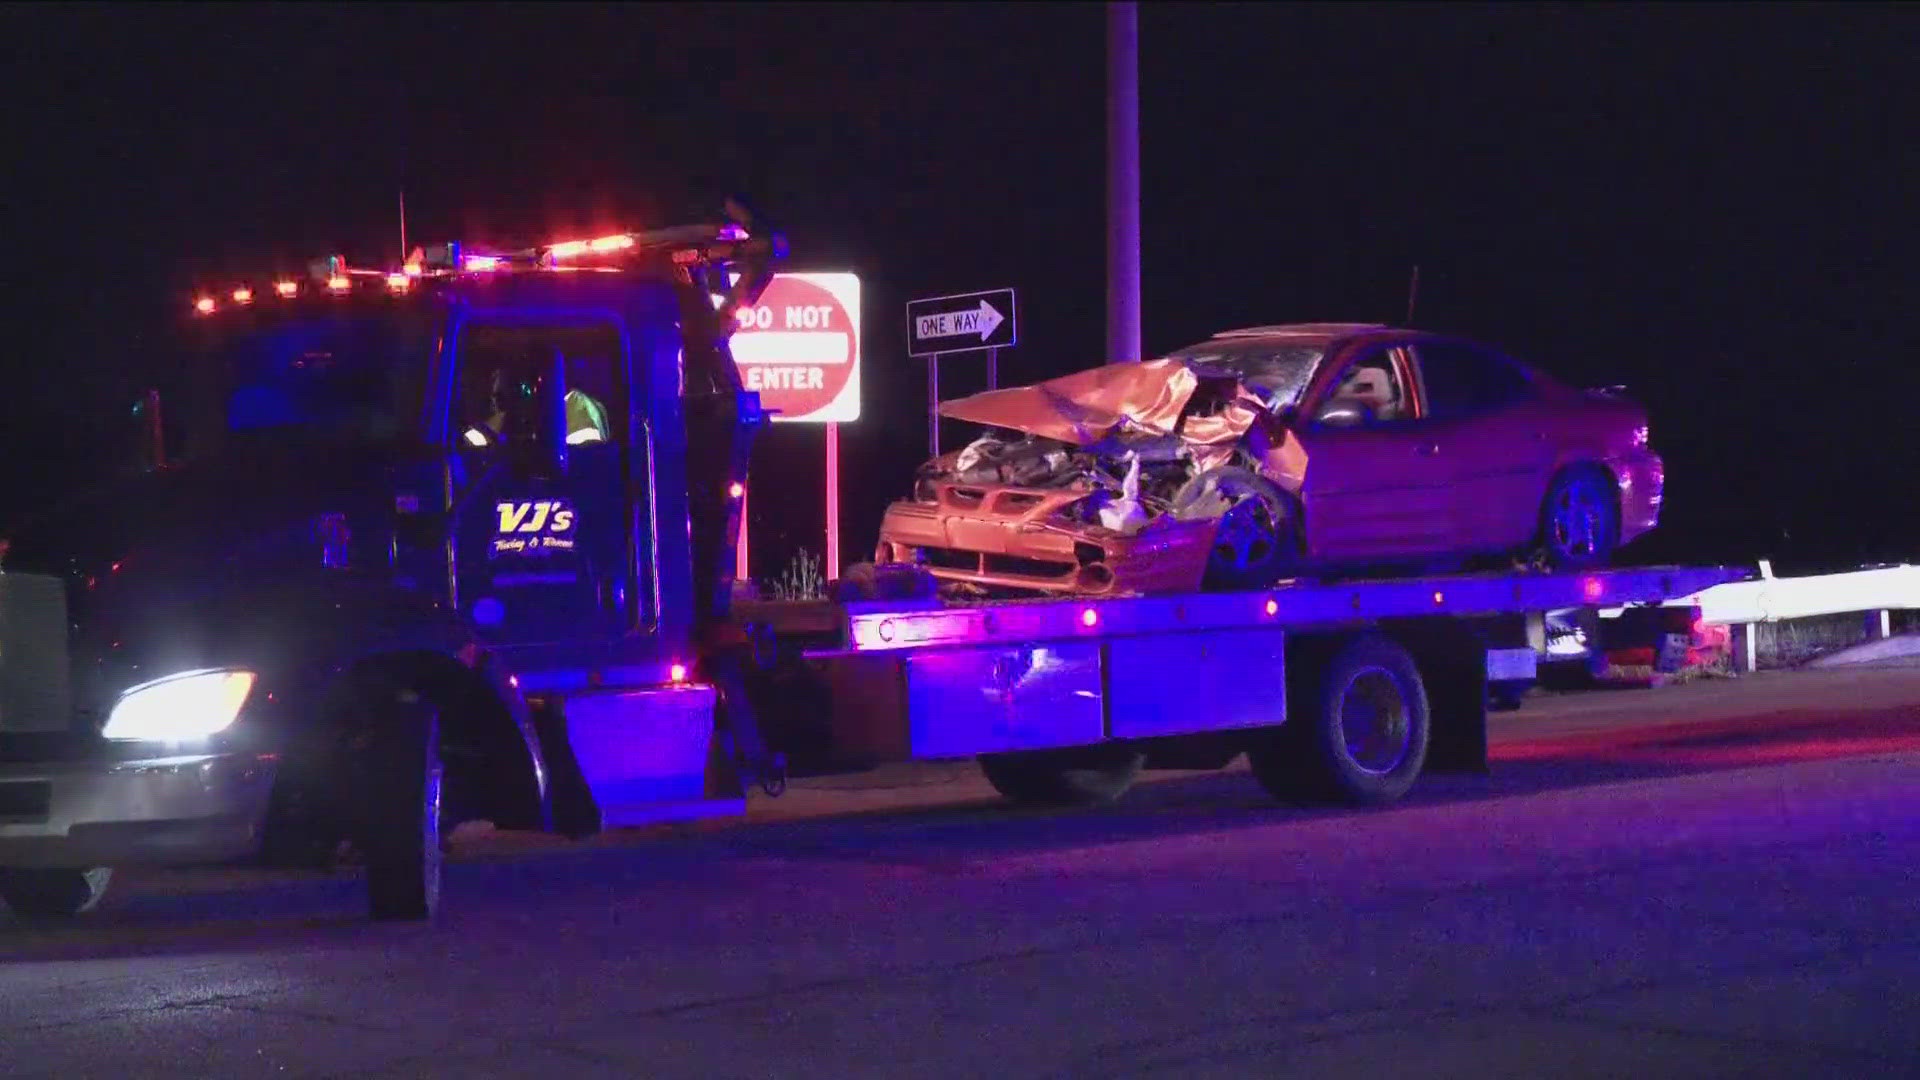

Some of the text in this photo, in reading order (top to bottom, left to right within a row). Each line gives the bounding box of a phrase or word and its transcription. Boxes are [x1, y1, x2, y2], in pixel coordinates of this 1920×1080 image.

[739, 305, 833, 329] DO NOT
[921, 312, 980, 336] ONE WAY
[747, 367, 824, 390] ENTER
[496, 501, 574, 533] VJ's
